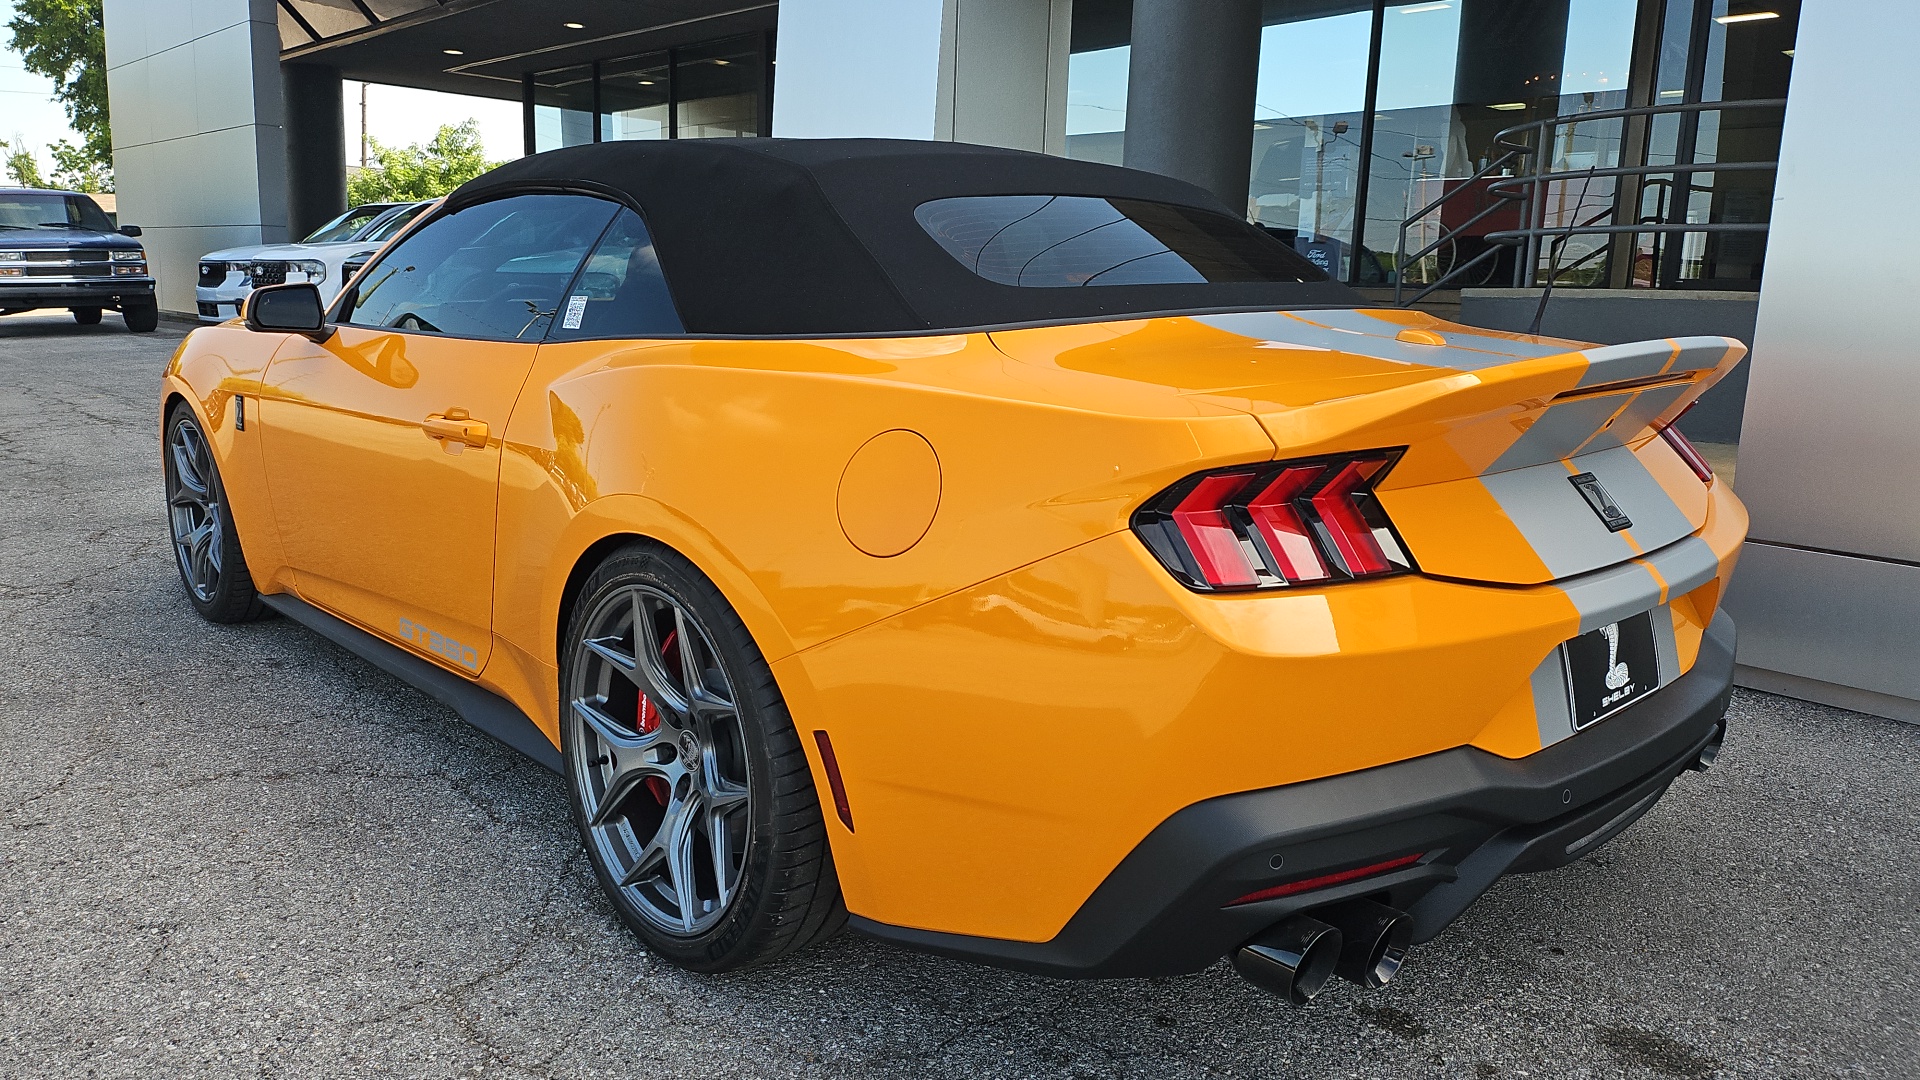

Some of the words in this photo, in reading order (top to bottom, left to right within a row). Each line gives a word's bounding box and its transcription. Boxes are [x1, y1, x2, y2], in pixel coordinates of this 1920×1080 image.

[1307, 249, 1327, 259] Ford
[399, 616, 479, 670] GT350
[1601, 682, 1636, 707] SHELBY
